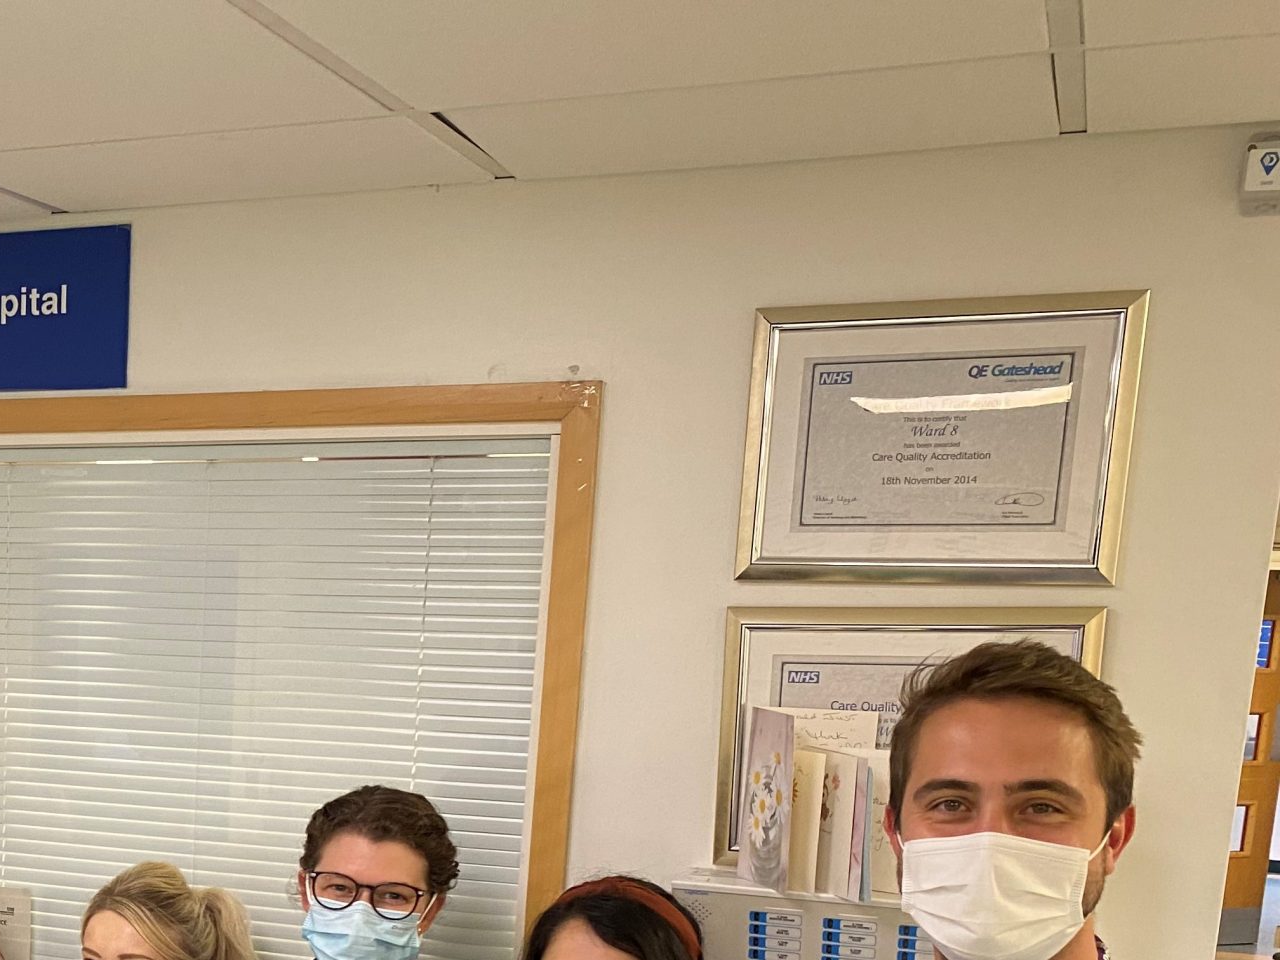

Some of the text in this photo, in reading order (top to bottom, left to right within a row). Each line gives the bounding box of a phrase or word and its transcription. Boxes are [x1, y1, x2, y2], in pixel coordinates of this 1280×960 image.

[821, 361, 1064, 385] NHS QE Gateshead
[911, 423, 959, 437] Ward 8
[872, 451, 991, 464] Care Quality Accreditation
[881, 475, 977, 486] 18th November 2014
[789, 671, 819, 683] NHS
[830, 700, 902, 715] Care Quality
